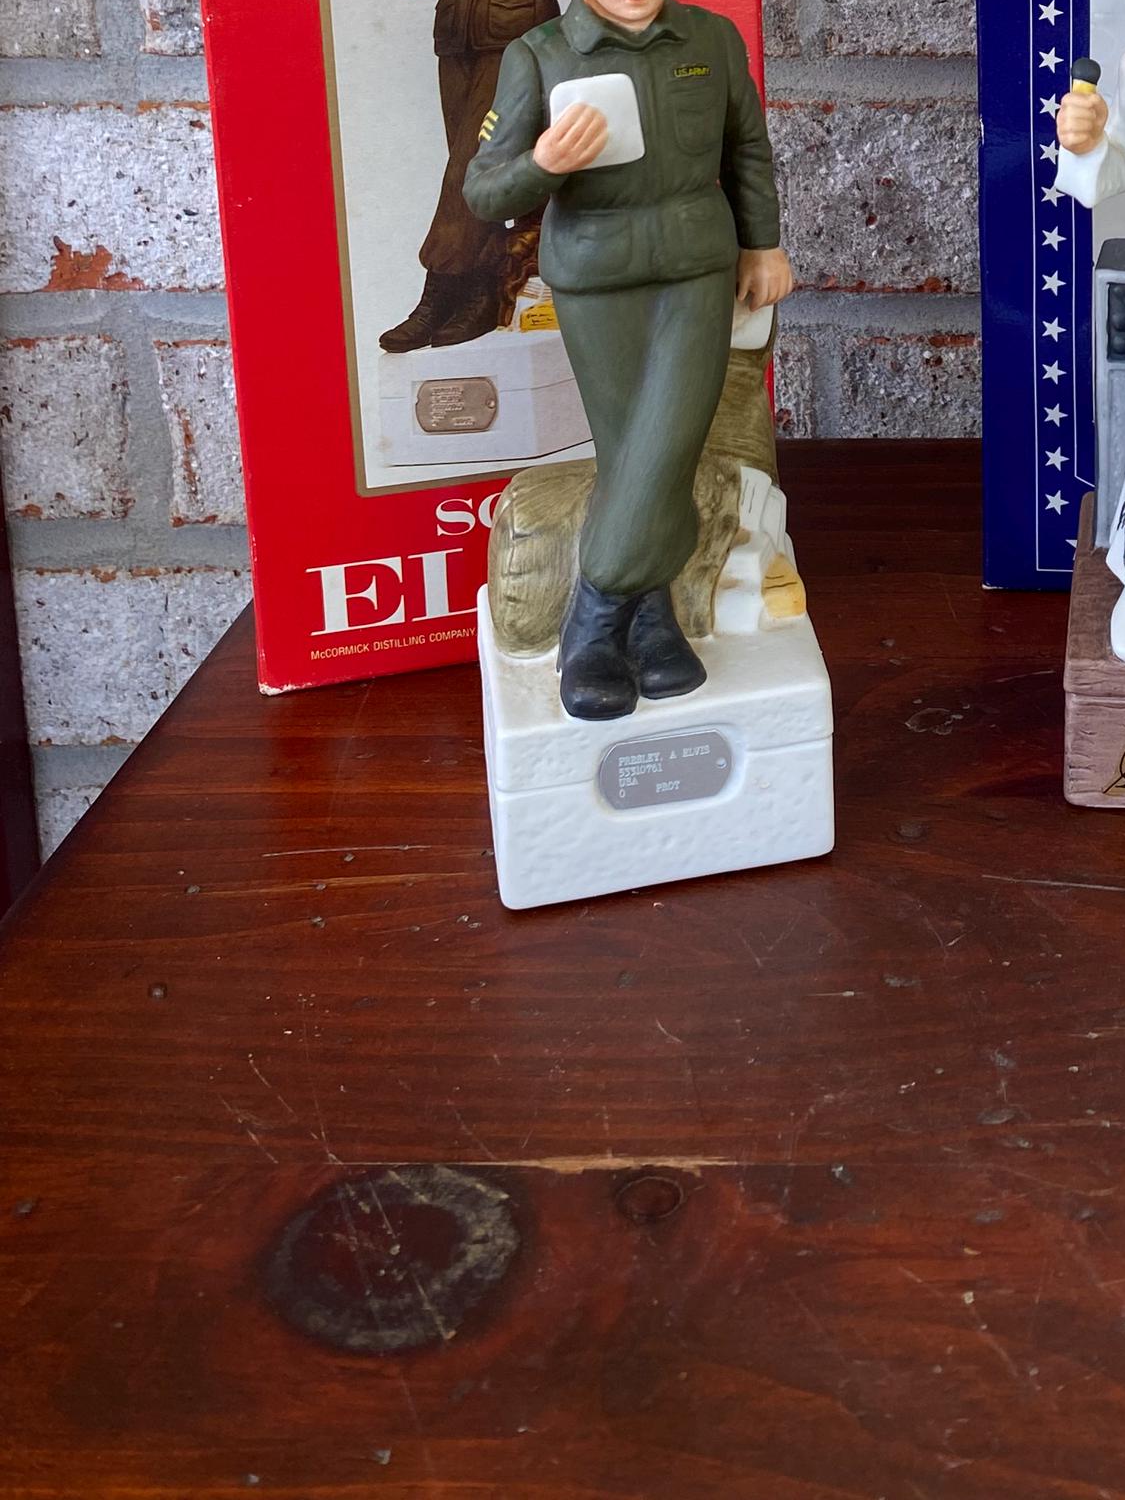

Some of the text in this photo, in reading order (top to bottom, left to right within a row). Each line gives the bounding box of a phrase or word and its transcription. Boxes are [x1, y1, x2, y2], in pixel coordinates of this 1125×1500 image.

[305, 547, 479, 637] EL
[310, 643, 370, 661] McCORMICK
[373, 634, 426, 651] DISTILLING
[669, 750, 678, 760] A
[682, 744, 711, 759] ELVIS
[618, 777, 639, 788] USA
[655, 780, 681, 794] PROT
